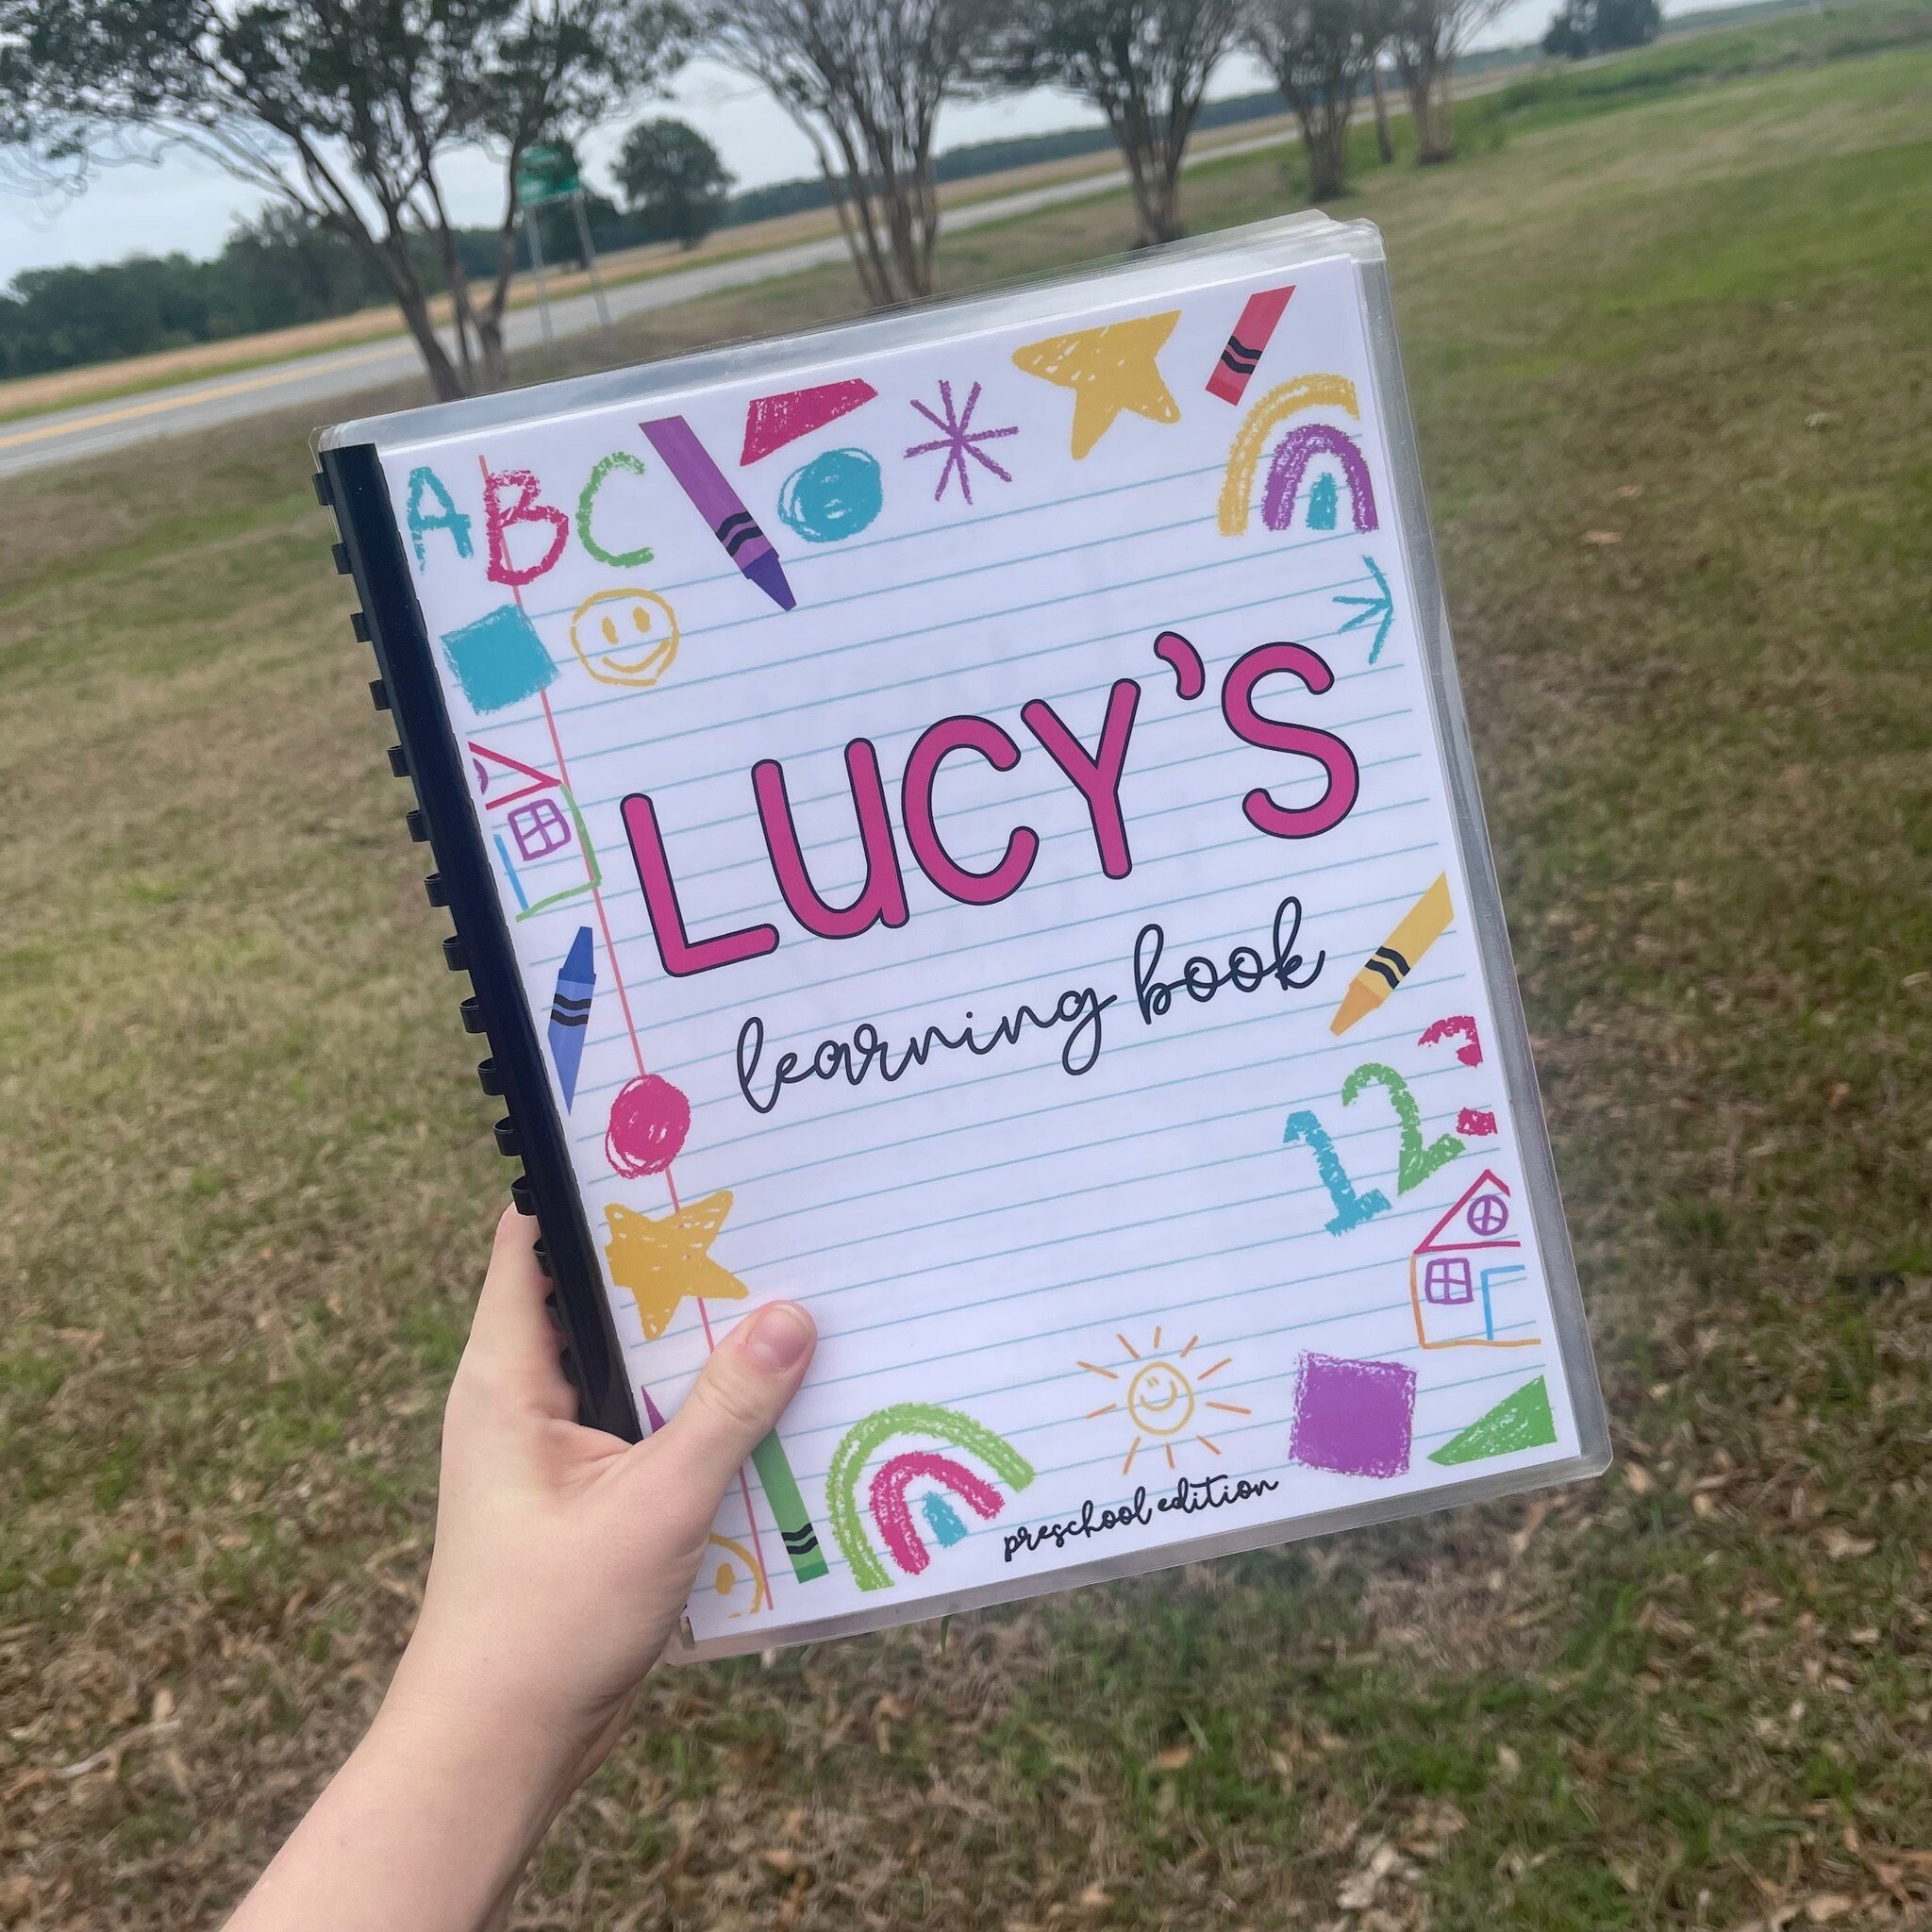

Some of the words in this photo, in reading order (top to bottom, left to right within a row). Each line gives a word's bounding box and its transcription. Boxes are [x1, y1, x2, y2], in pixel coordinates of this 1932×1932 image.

[407, 451, 655, 585] ABC
[620, 631, 1359, 976] LUCY'S
[736, 985, 1117, 1113] learning
[1133, 896, 1325, 1024] book
[1003, 1485, 1153, 1562] preschool
[1157, 1474, 1279, 1514] edition
